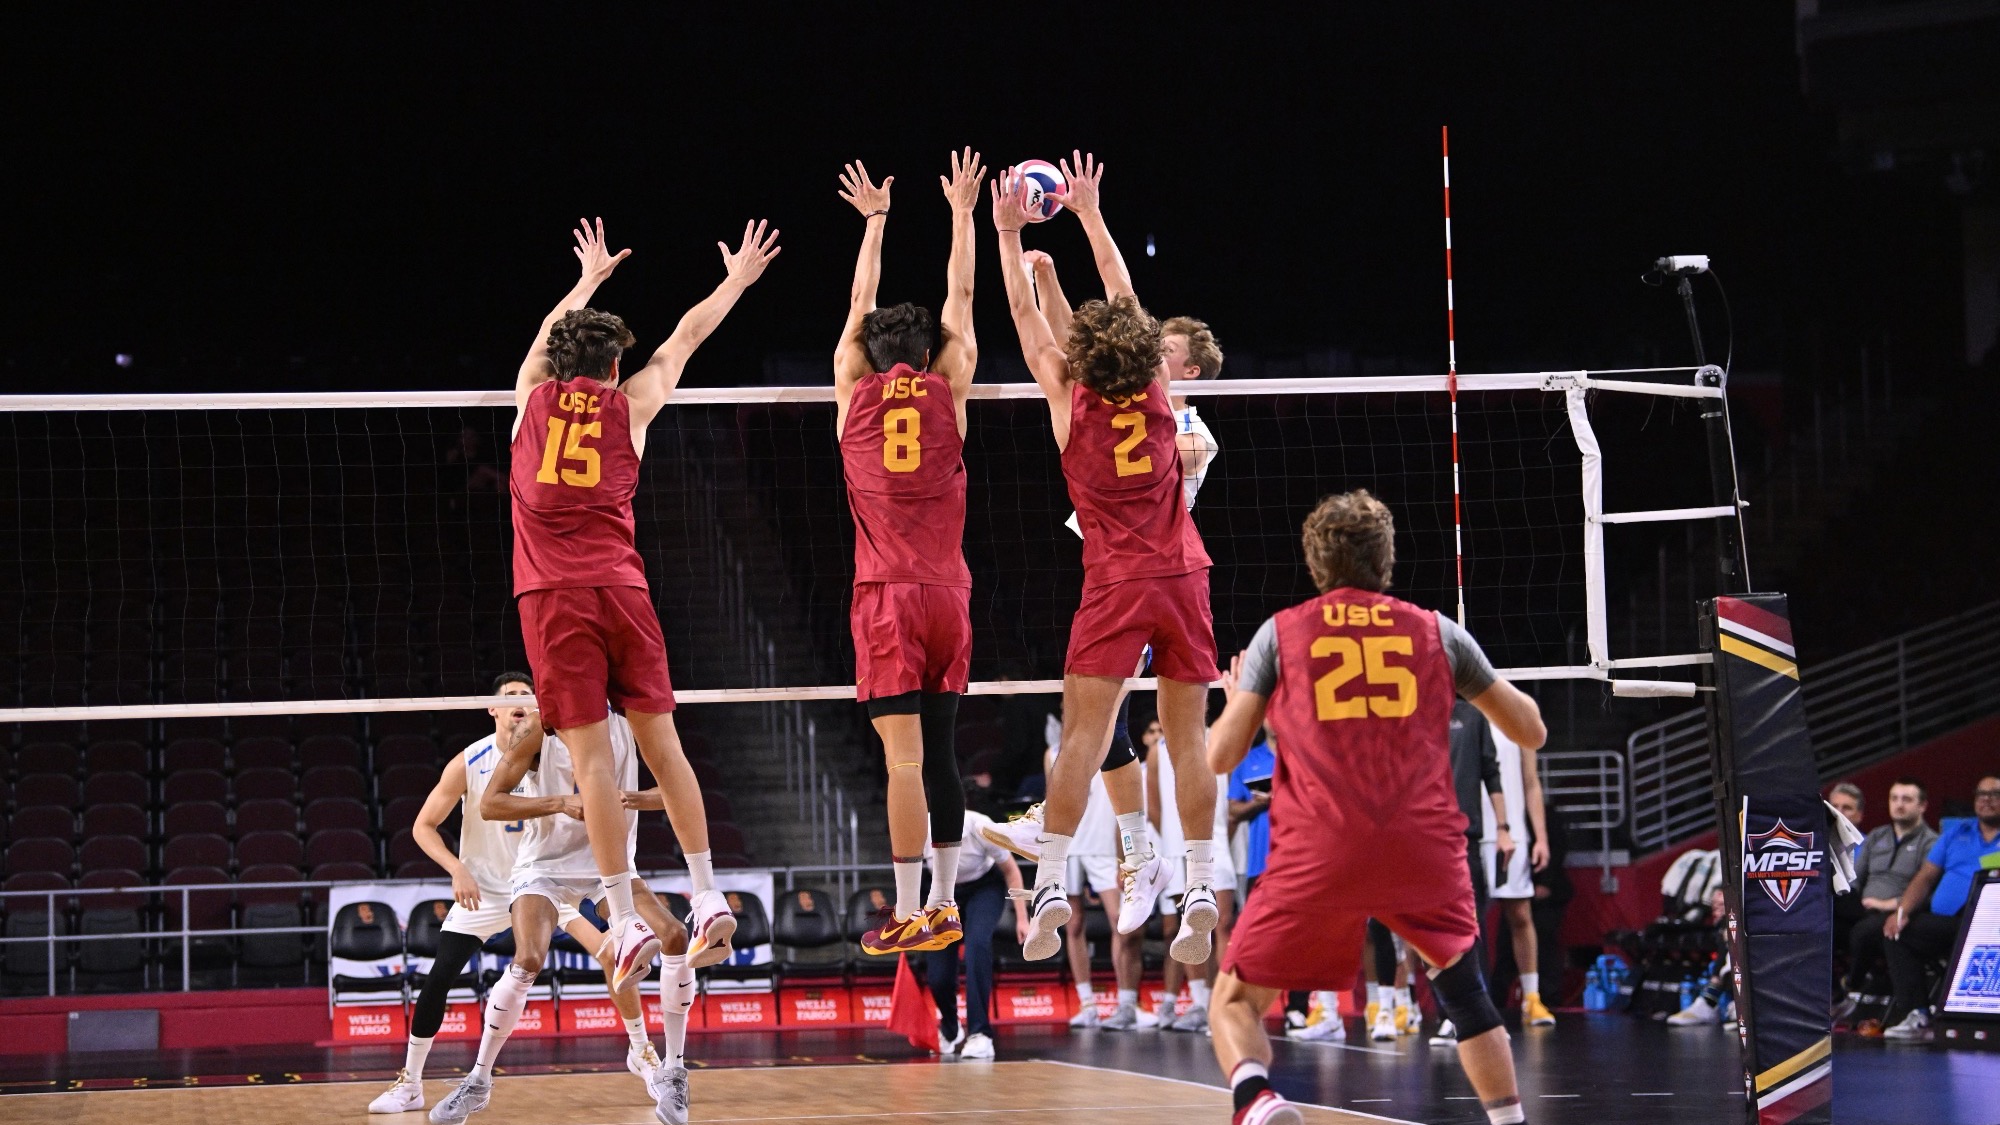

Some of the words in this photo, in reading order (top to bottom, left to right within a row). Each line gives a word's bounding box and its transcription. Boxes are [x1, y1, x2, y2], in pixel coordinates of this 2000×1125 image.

[882, 377, 927, 400] USC
[559, 392, 600, 413] USC
[884, 407, 921, 472] 8
[1111, 411, 1152, 477] 2
[536, 416, 602, 488] 15
[1322, 603, 1394, 626] USC
[1310, 636, 1417, 721] 25
[1744, 851, 1823, 872] MPSF
[795, 999, 836, 1010] WELLS
[1011, 995, 1053, 1006] WELLS
[575, 1007, 616, 1018] WELLS
[721, 1002, 761, 1012] WELLS
[1013, 1006, 1054, 1017] FARGO
[348, 1014, 390, 1025] WELLS
[722, 1013, 762, 1023] FARGO
[796, 1010, 837, 1020] FARGO
[576, 1018, 617, 1029] FARGO
[349, 1025, 391, 1035] FARGO
